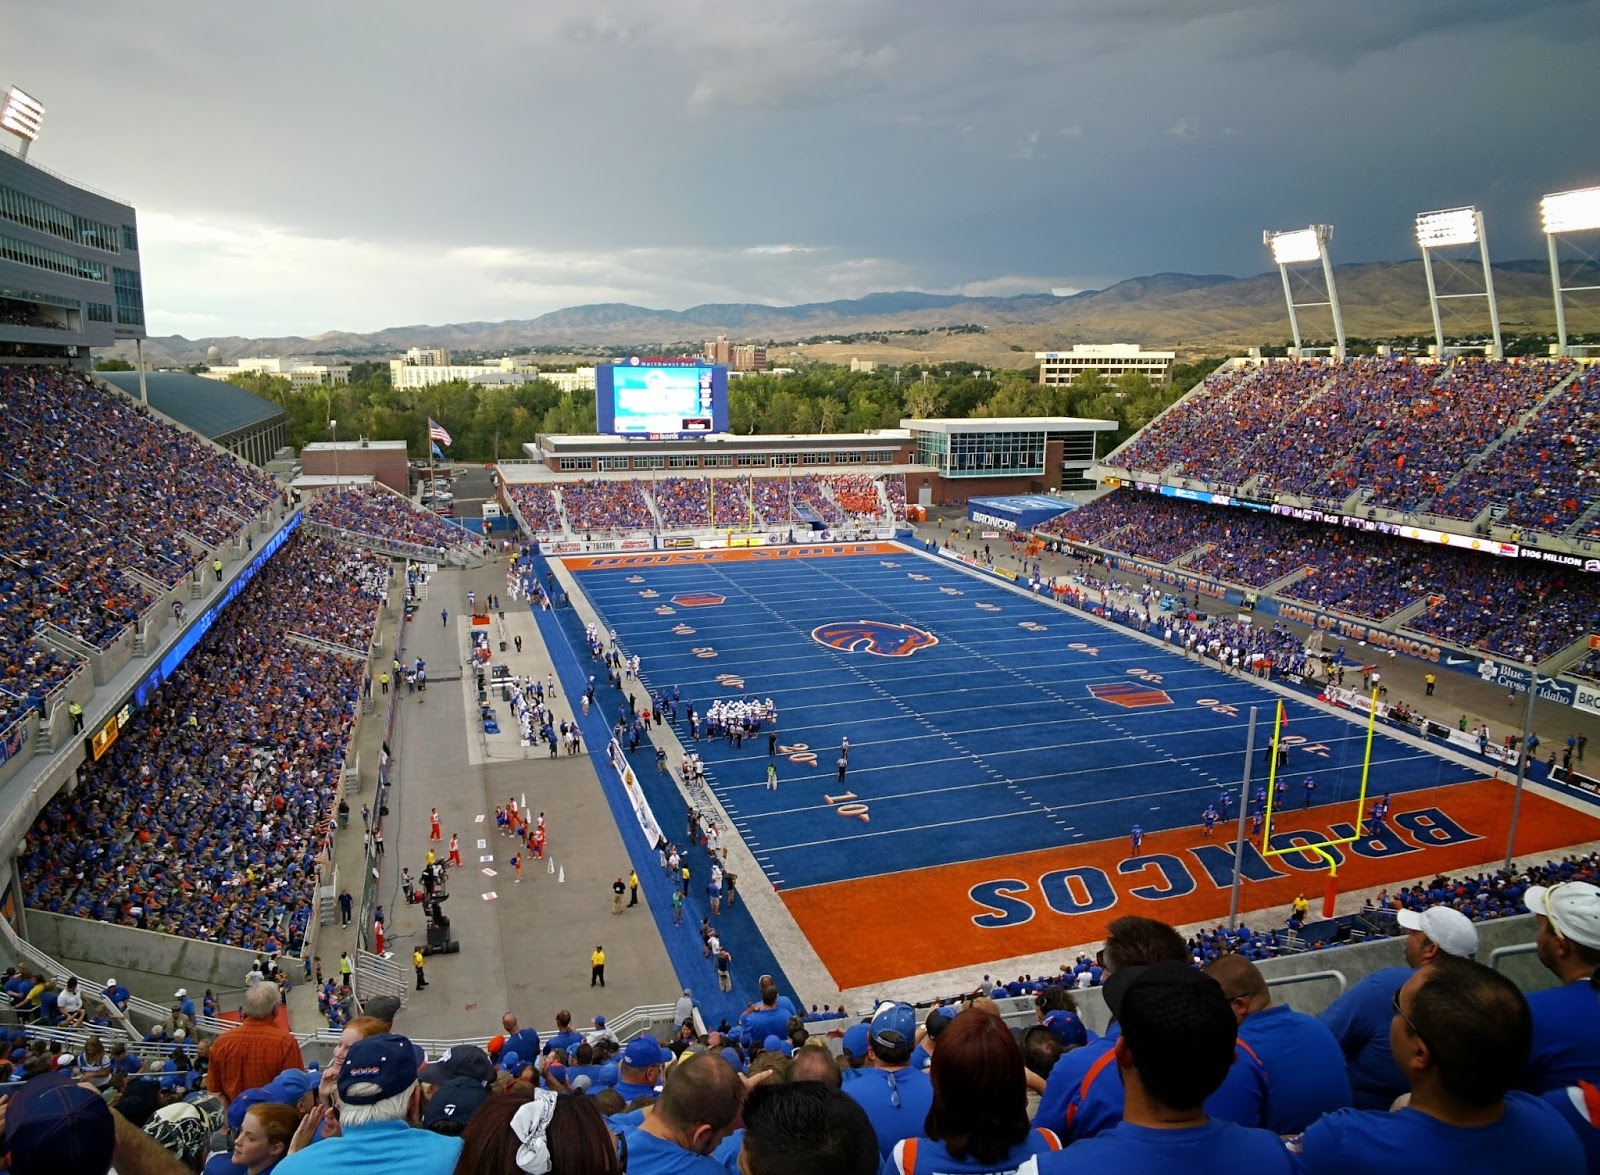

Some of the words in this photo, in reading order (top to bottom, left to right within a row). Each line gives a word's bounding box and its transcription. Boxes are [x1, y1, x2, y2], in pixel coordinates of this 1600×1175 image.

[973, 512, 1017, 531] BRONCOS
[589, 553, 726, 567] BOISE
[1521, 549, 1541, 559] $106
[1543, 553, 1582, 567] MILLION
[1118, 558, 1162, 581] WELCOME
[1163, 571, 1176, 585] TO
[1178, 574, 1198, 592] THE
[1199, 580, 1227, 600] BLUE
[1279, 603, 1315, 626] HOME
[1317, 614, 1337, 631] OF
[1339, 619, 1366, 640] THE
[1367, 629, 1442, 663] BRONCOS
[1500, 664, 1525, 680] Blue
[1498, 675, 1526, 692] Cross
[1539, 687, 1570, 705] Idaho
[1356, 699, 1379, 712] ONIOS
[778, 743, 818, 763] 20
[824, 791, 870, 816] 10
[969, 806, 1487, 930] BRONCOS
